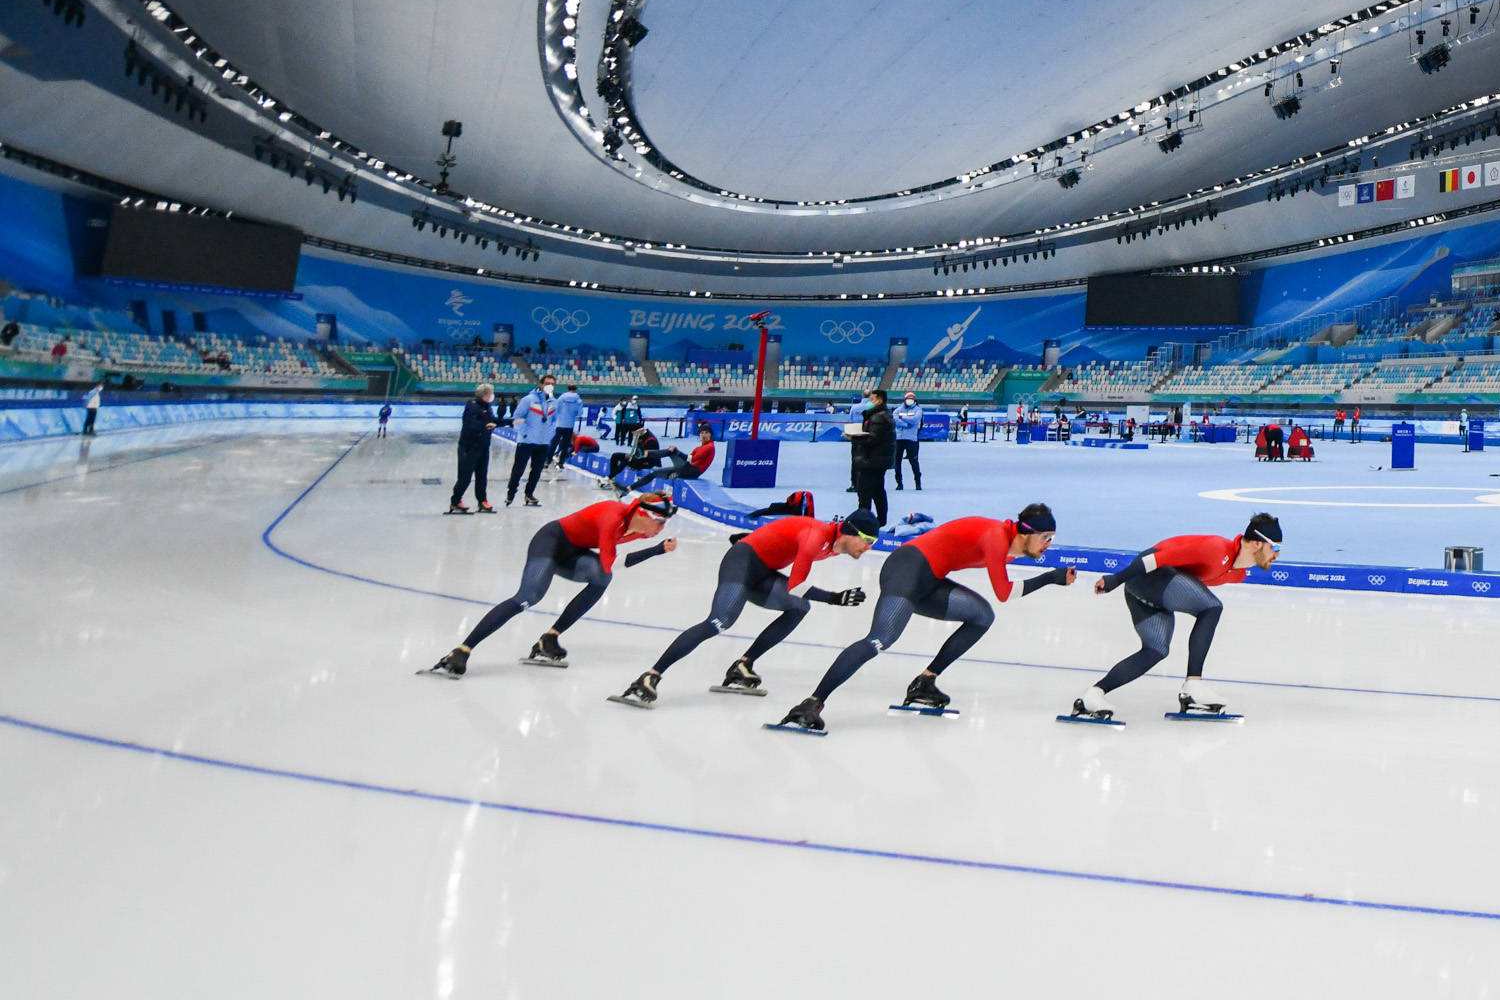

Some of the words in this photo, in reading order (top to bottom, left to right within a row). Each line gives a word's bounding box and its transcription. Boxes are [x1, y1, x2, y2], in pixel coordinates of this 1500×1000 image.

[628, 309, 715, 334] BEIJING
[728, 419, 781, 435] BEIING
[1408, 577, 1430, 587] BEIJING
[1431, 579, 1448, 587] 2022
